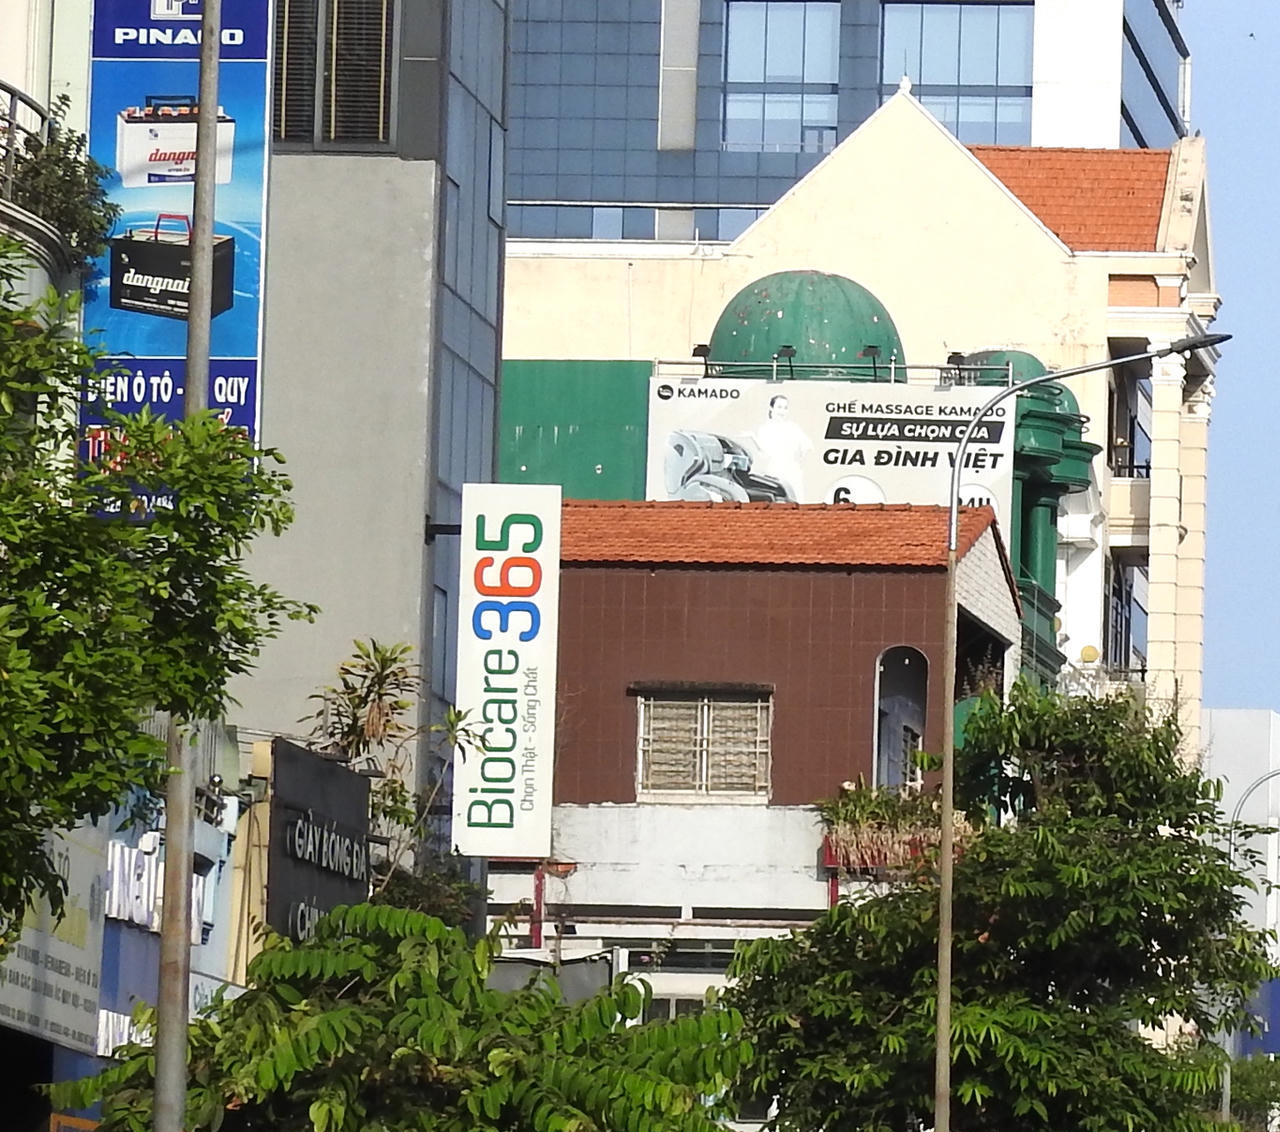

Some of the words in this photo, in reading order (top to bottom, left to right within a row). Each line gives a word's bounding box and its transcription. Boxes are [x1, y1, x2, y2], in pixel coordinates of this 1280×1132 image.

[114, 28, 244, 45] PINAO
[150, 369, 173, 402] TÔ
[214, 376, 249, 405] QUY
[677, 387, 740, 400] KAMADO
[825, 400, 857, 414] GHẾ
[861, 402, 933, 416] MASSAGE
[938, 404, 1006, 417] KAMADO
[840, 421, 866, 437] SỰ
[867, 422, 899, 437] LỰA
[903, 424, 952, 441] CHỌN
[823, 448, 866, 466] GIA
[873, 445, 938, 468] ĐÌNH
[472, 513, 543, 642] 365
[522, 666, 538, 697] Chất
[521, 699, 541, 733] Sống
[467, 647, 520, 829] Biocare
[522, 746, 539, 776] Thật
[520, 777, 538, 812] Chọn
